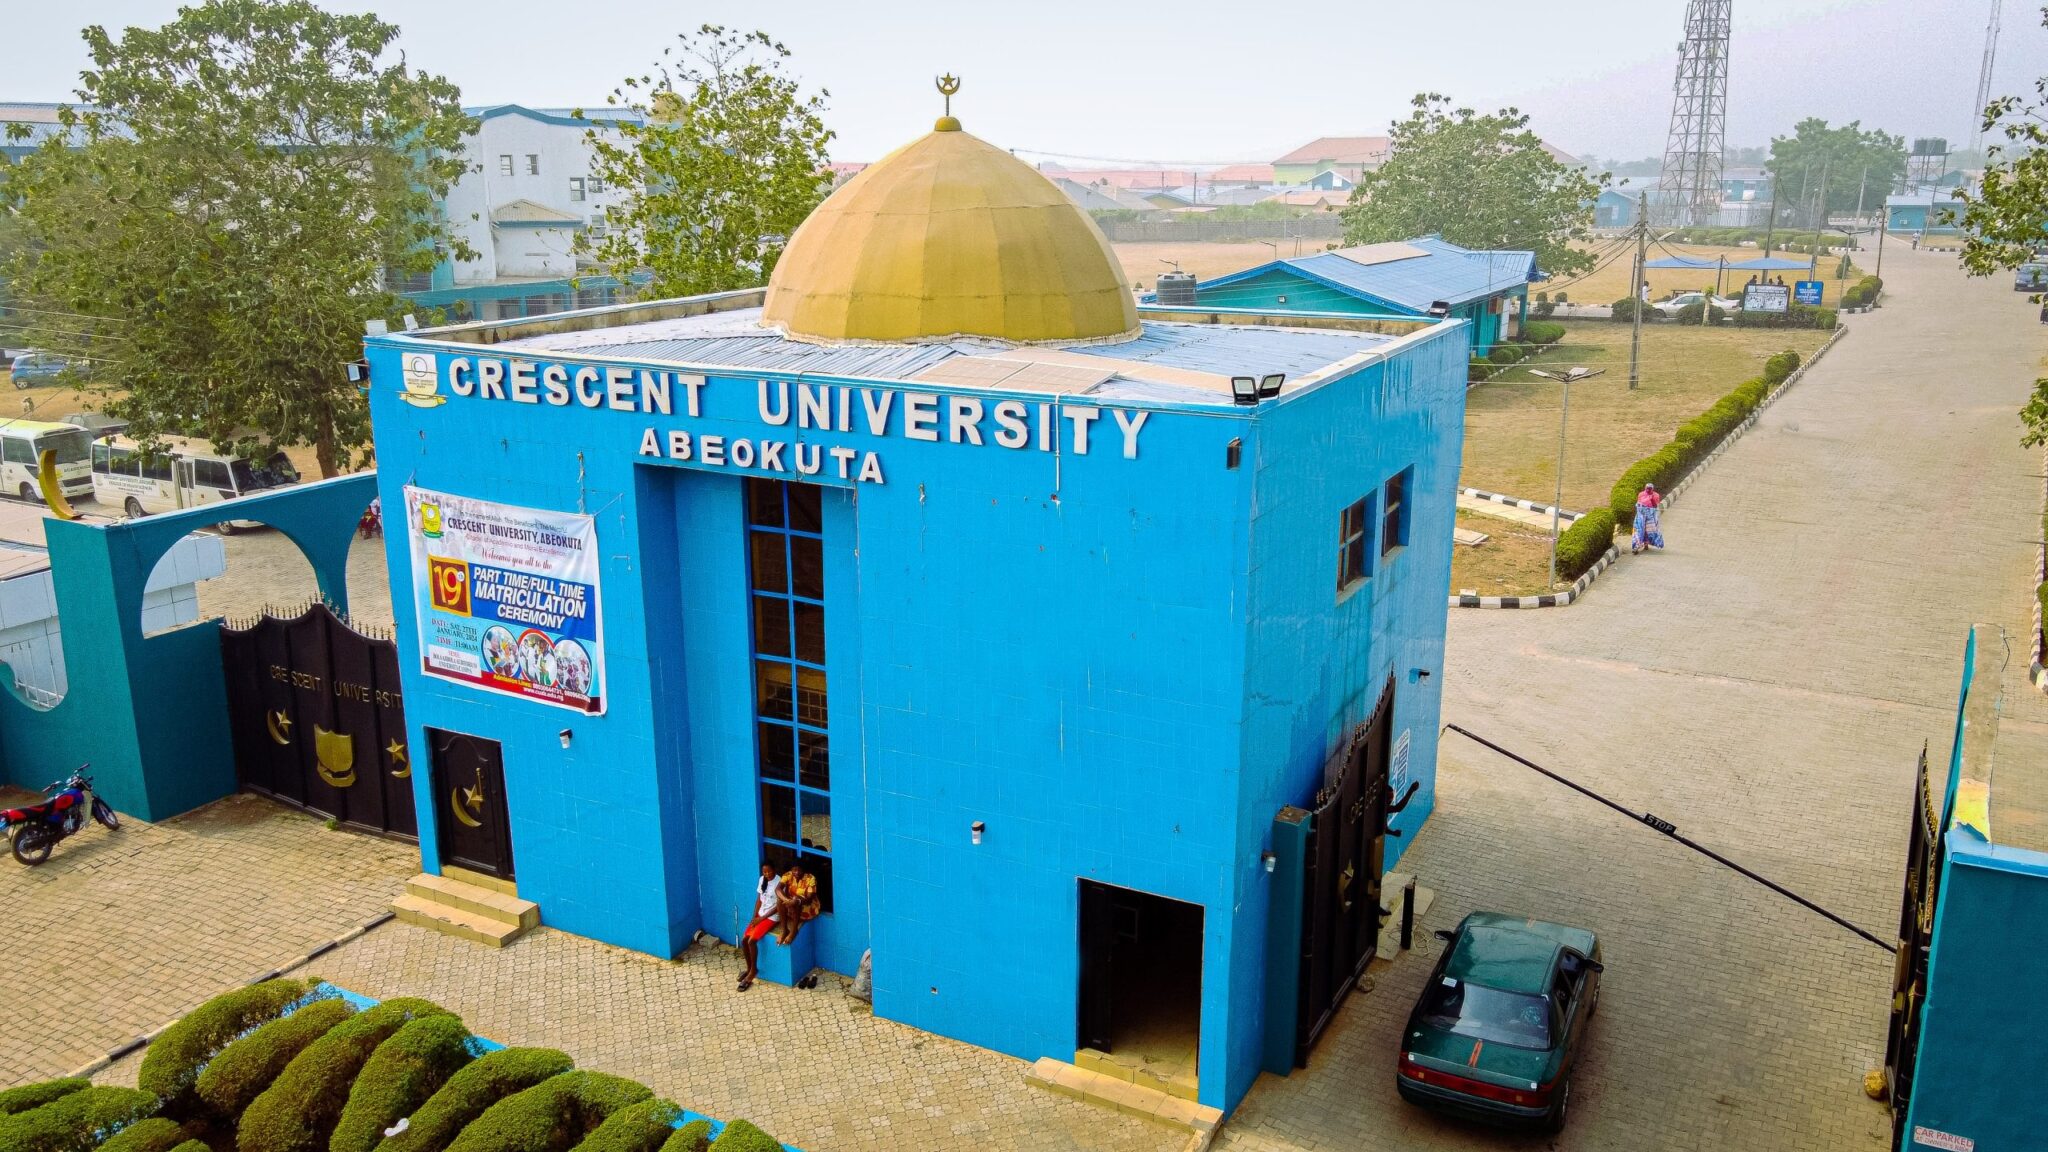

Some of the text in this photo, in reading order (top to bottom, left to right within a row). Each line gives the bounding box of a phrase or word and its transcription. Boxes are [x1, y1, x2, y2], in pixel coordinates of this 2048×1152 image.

[449, 357, 1151, 460] CRESCENT UNIVERSITY
[639, 427, 885, 485] ABEOKUTA
[447, 517, 582, 551] CRESCENT UNIVERSITY, ABEOKUTA
[512, 556, 523, 567] you
[525, 556, 534, 566] all
[535, 558, 542, 568] to
[542, 559, 553, 570] the
[433, 565, 462, 606] 19
[474, 566, 585, 599] PART TIME/FULL TIME
[474, 581, 587, 618] MATRICULATION
[497, 603, 565, 629] CEREMONY
[1646, 815, 1674, 832] STOP
[1915, 1127, 1973, 1148] CAR PARKED
